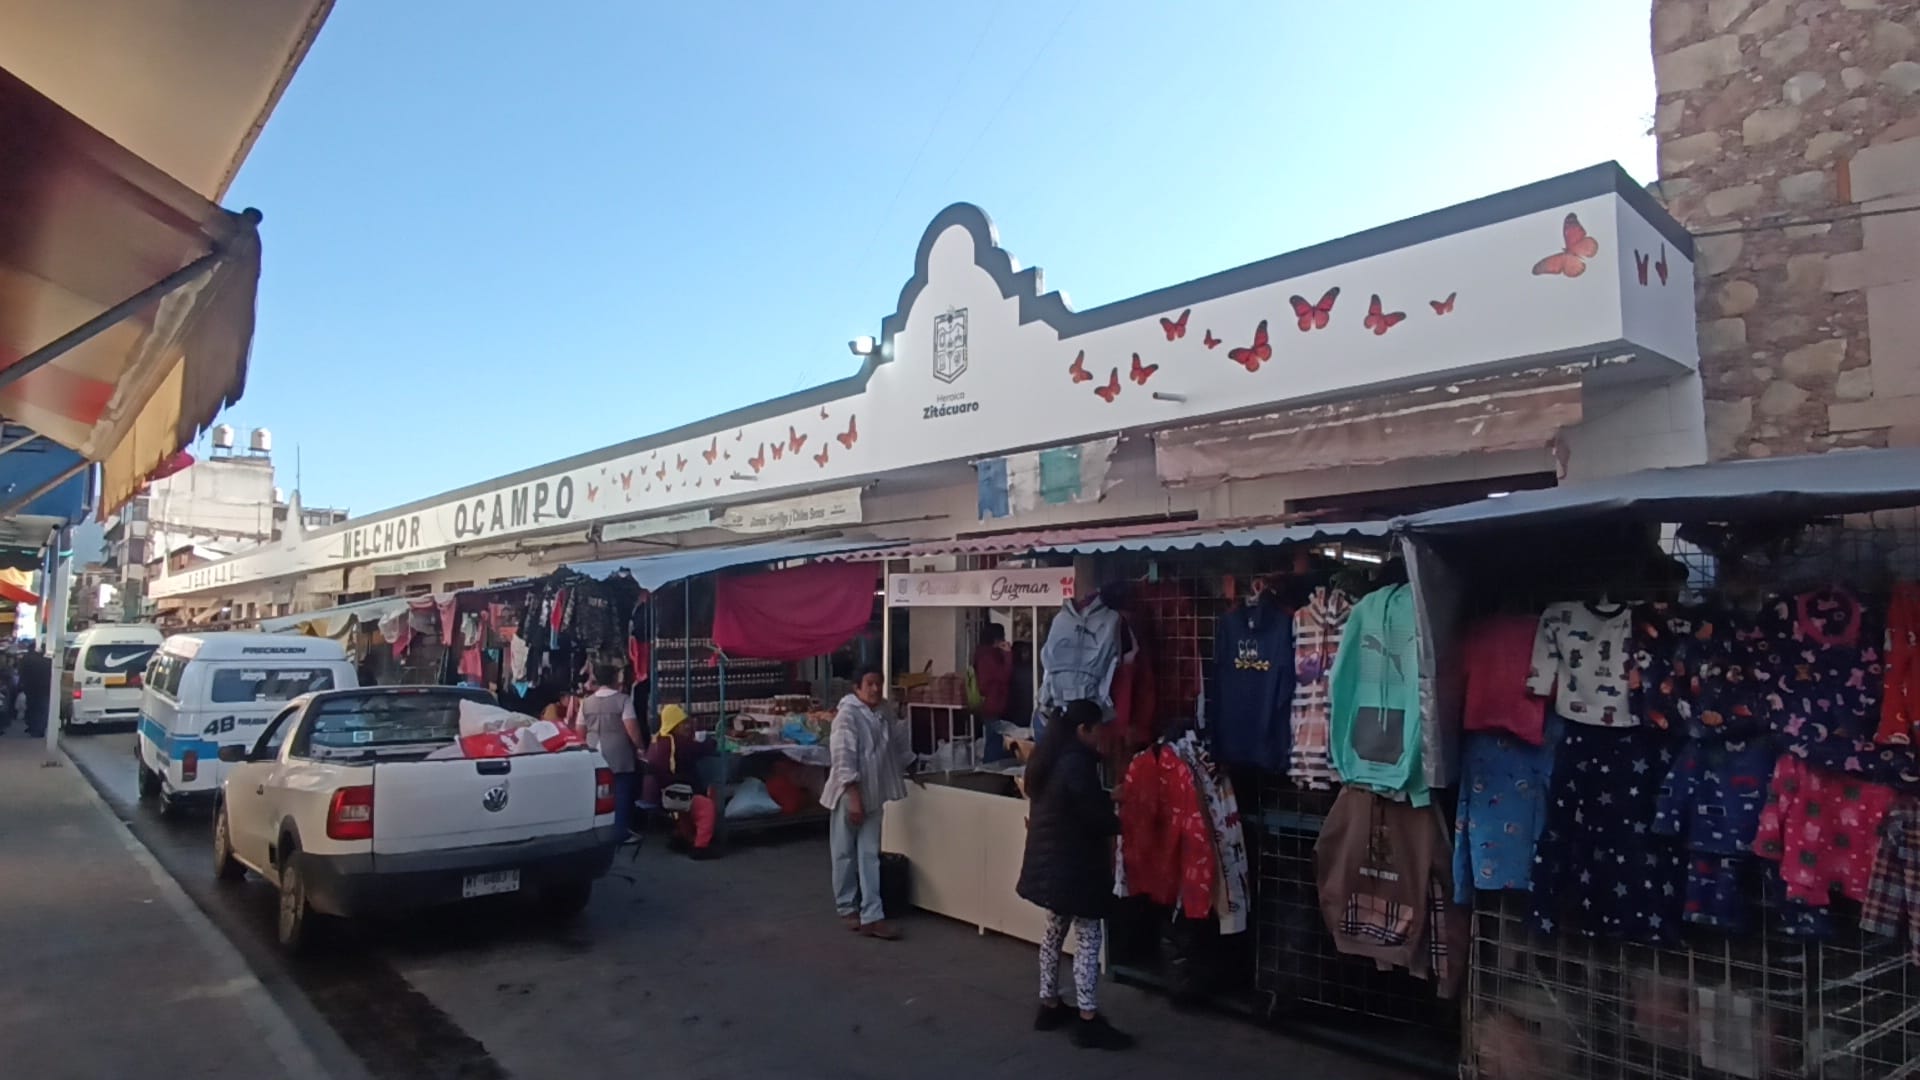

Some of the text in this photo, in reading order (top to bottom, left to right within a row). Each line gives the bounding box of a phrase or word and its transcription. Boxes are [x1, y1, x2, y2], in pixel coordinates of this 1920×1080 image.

[923, 401, 980, 420] Zitácuaro
[342, 515, 421, 559] MELCHOR
[453, 475, 575, 539] OCAMPO
[991, 576, 1050, 601] Guzman
[242, 646, 307, 655] PRECAUCION
